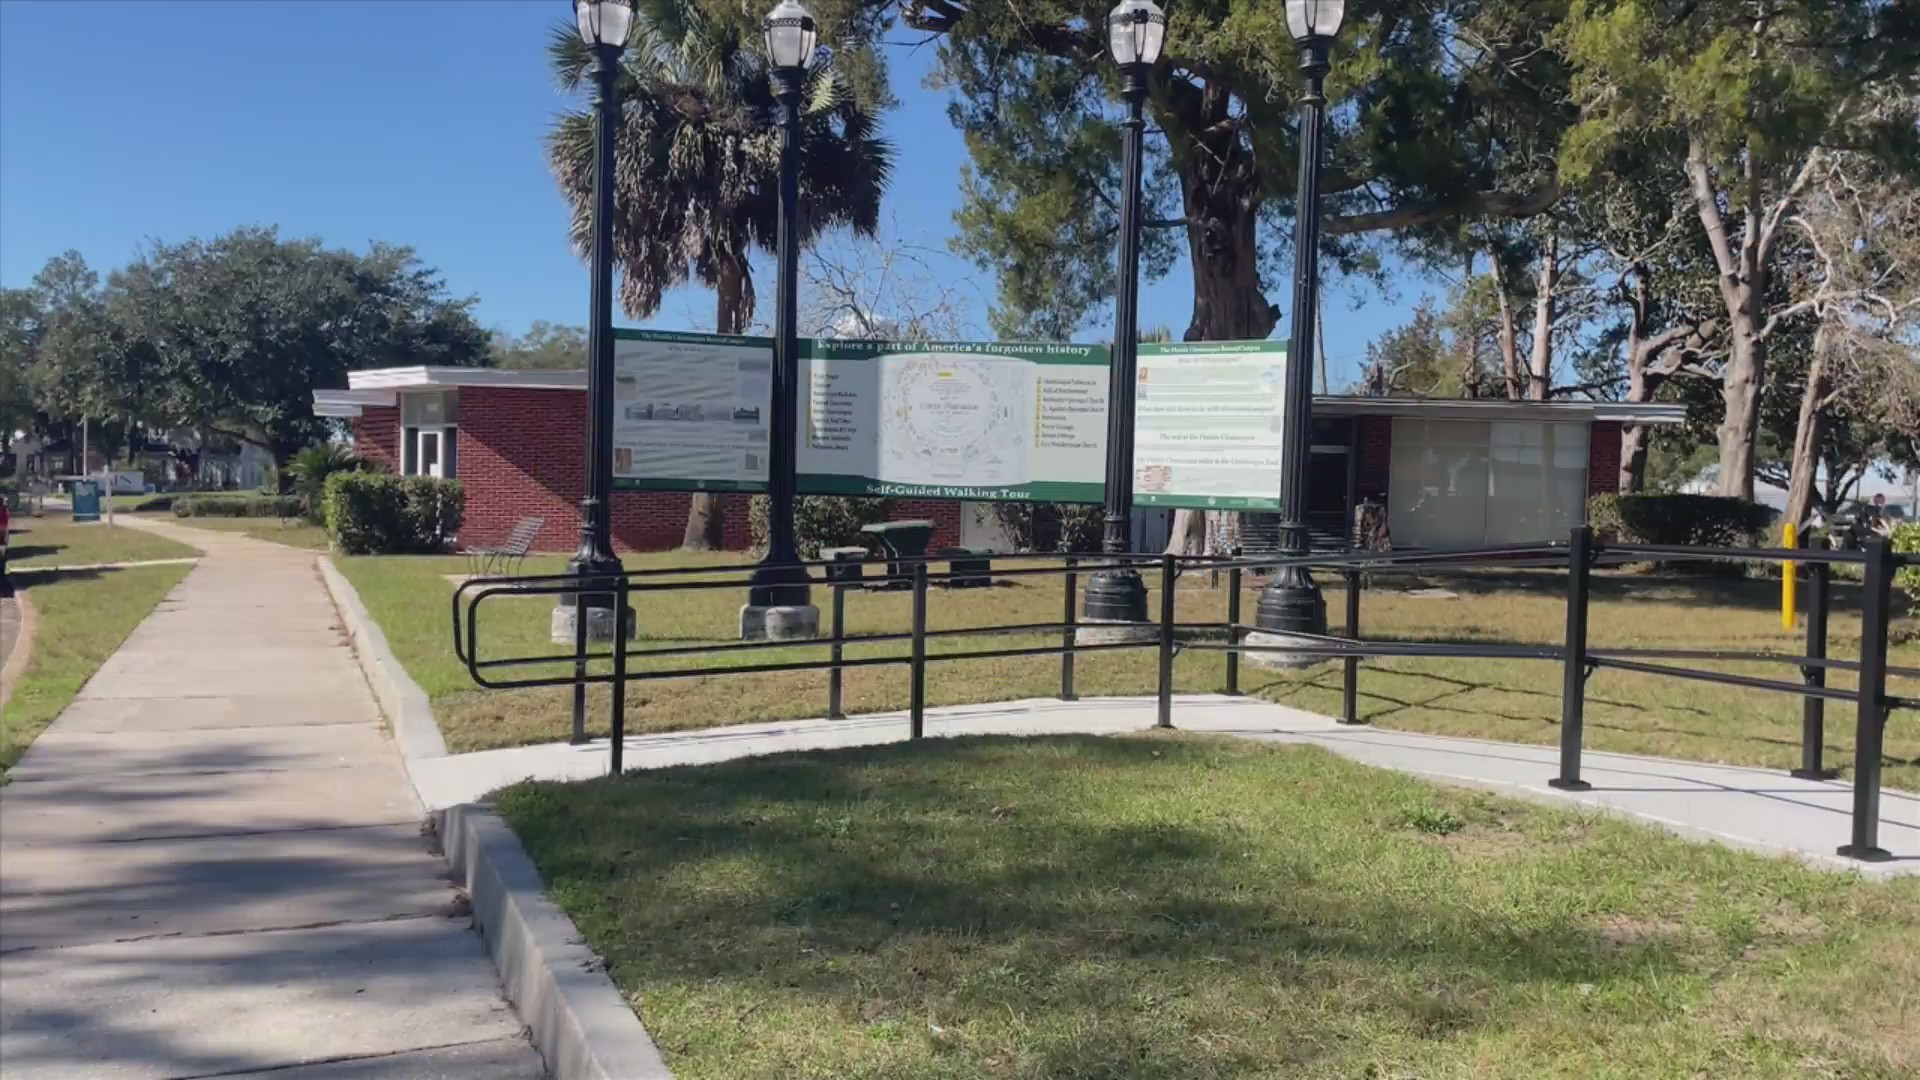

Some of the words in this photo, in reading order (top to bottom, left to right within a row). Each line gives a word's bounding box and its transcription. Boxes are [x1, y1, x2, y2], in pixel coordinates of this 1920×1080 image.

[817, 340, 864, 352] Explore
[866, 342, 873, 350] a
[877, 342, 902, 352] part
[905, 341, 917, 352] of
[921, 341, 982, 352] America's
[985, 343, 1043, 355] forgotten
[1046, 344, 1092, 357] history
[866, 484, 941, 497] Self-Guided
[943, 486, 997, 499] Walking
[1000, 488, 1032, 499] Tour
